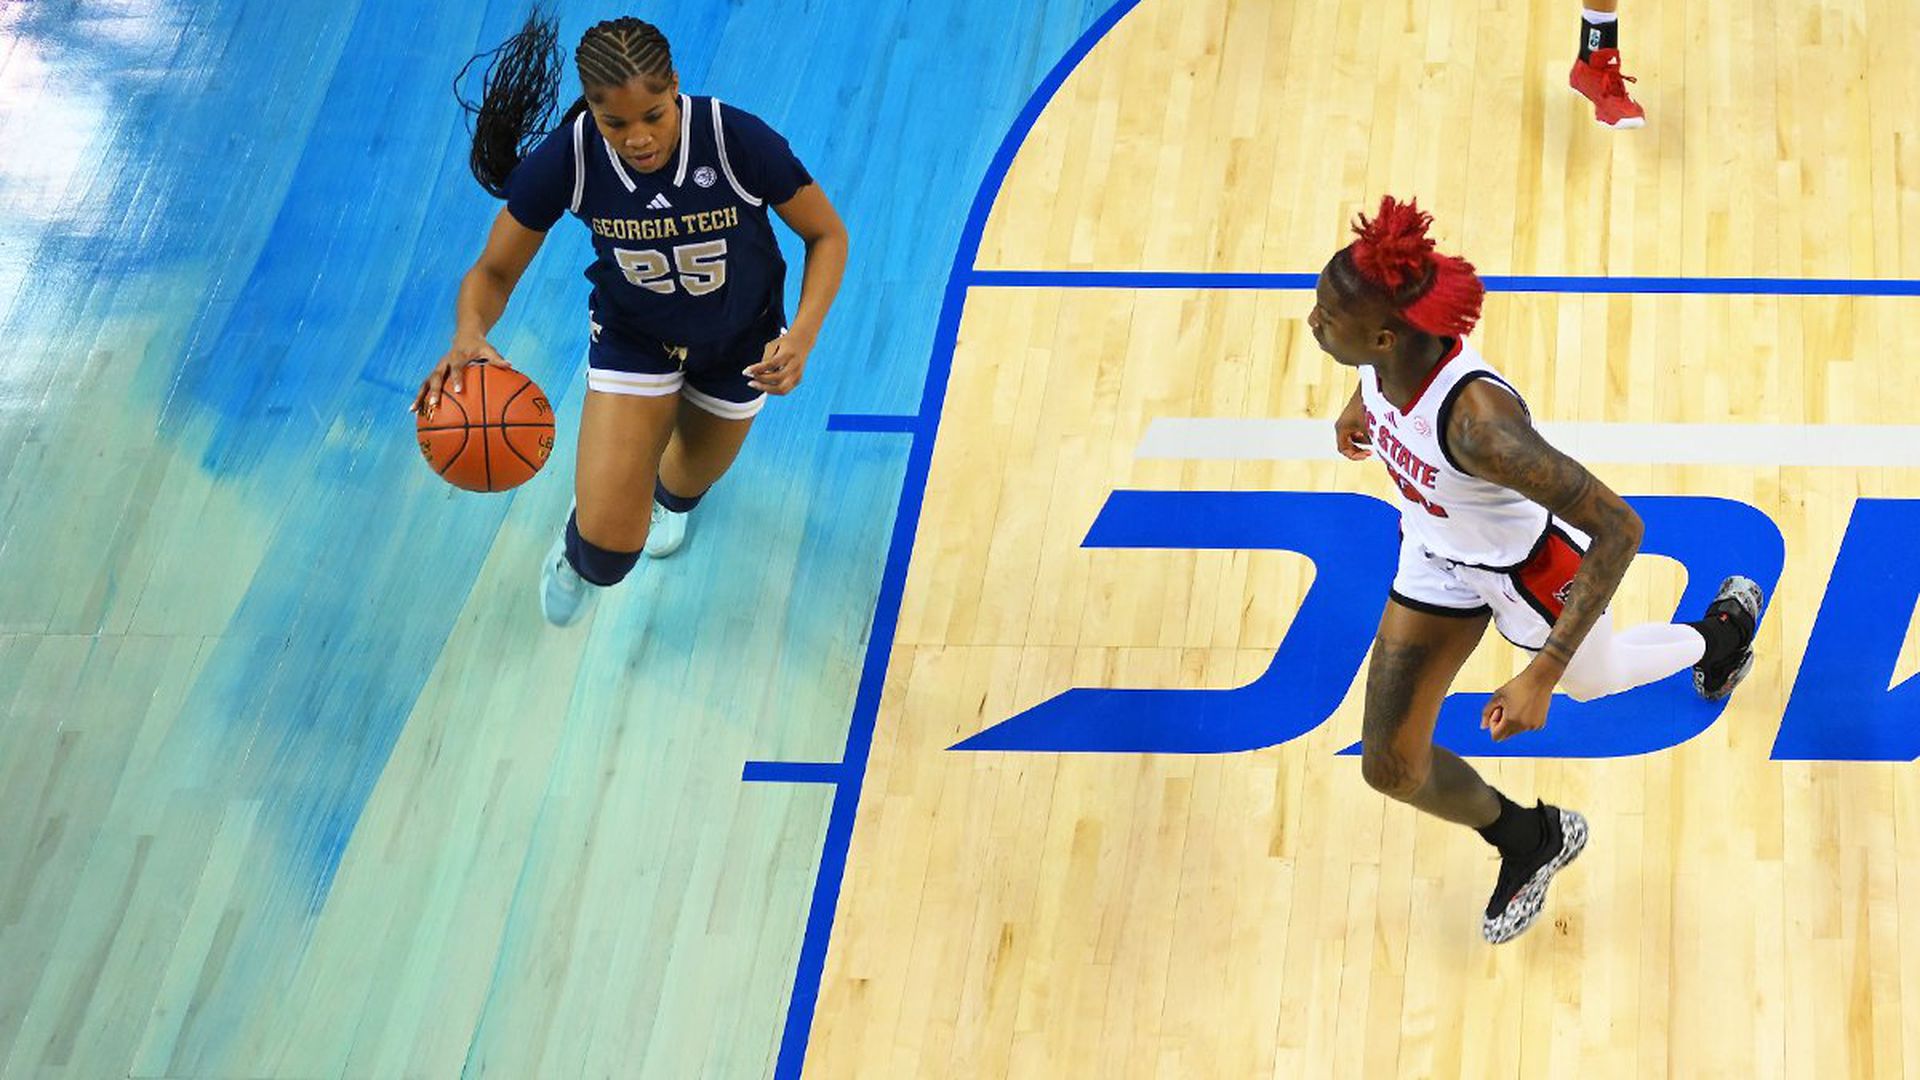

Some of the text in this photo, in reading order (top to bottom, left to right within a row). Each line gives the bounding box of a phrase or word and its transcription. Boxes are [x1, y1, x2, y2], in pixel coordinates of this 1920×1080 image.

[592, 206, 739, 240] GEORGIA TECH
[613, 238, 728, 296] 25
[1377, 425, 1440, 490] STATE
